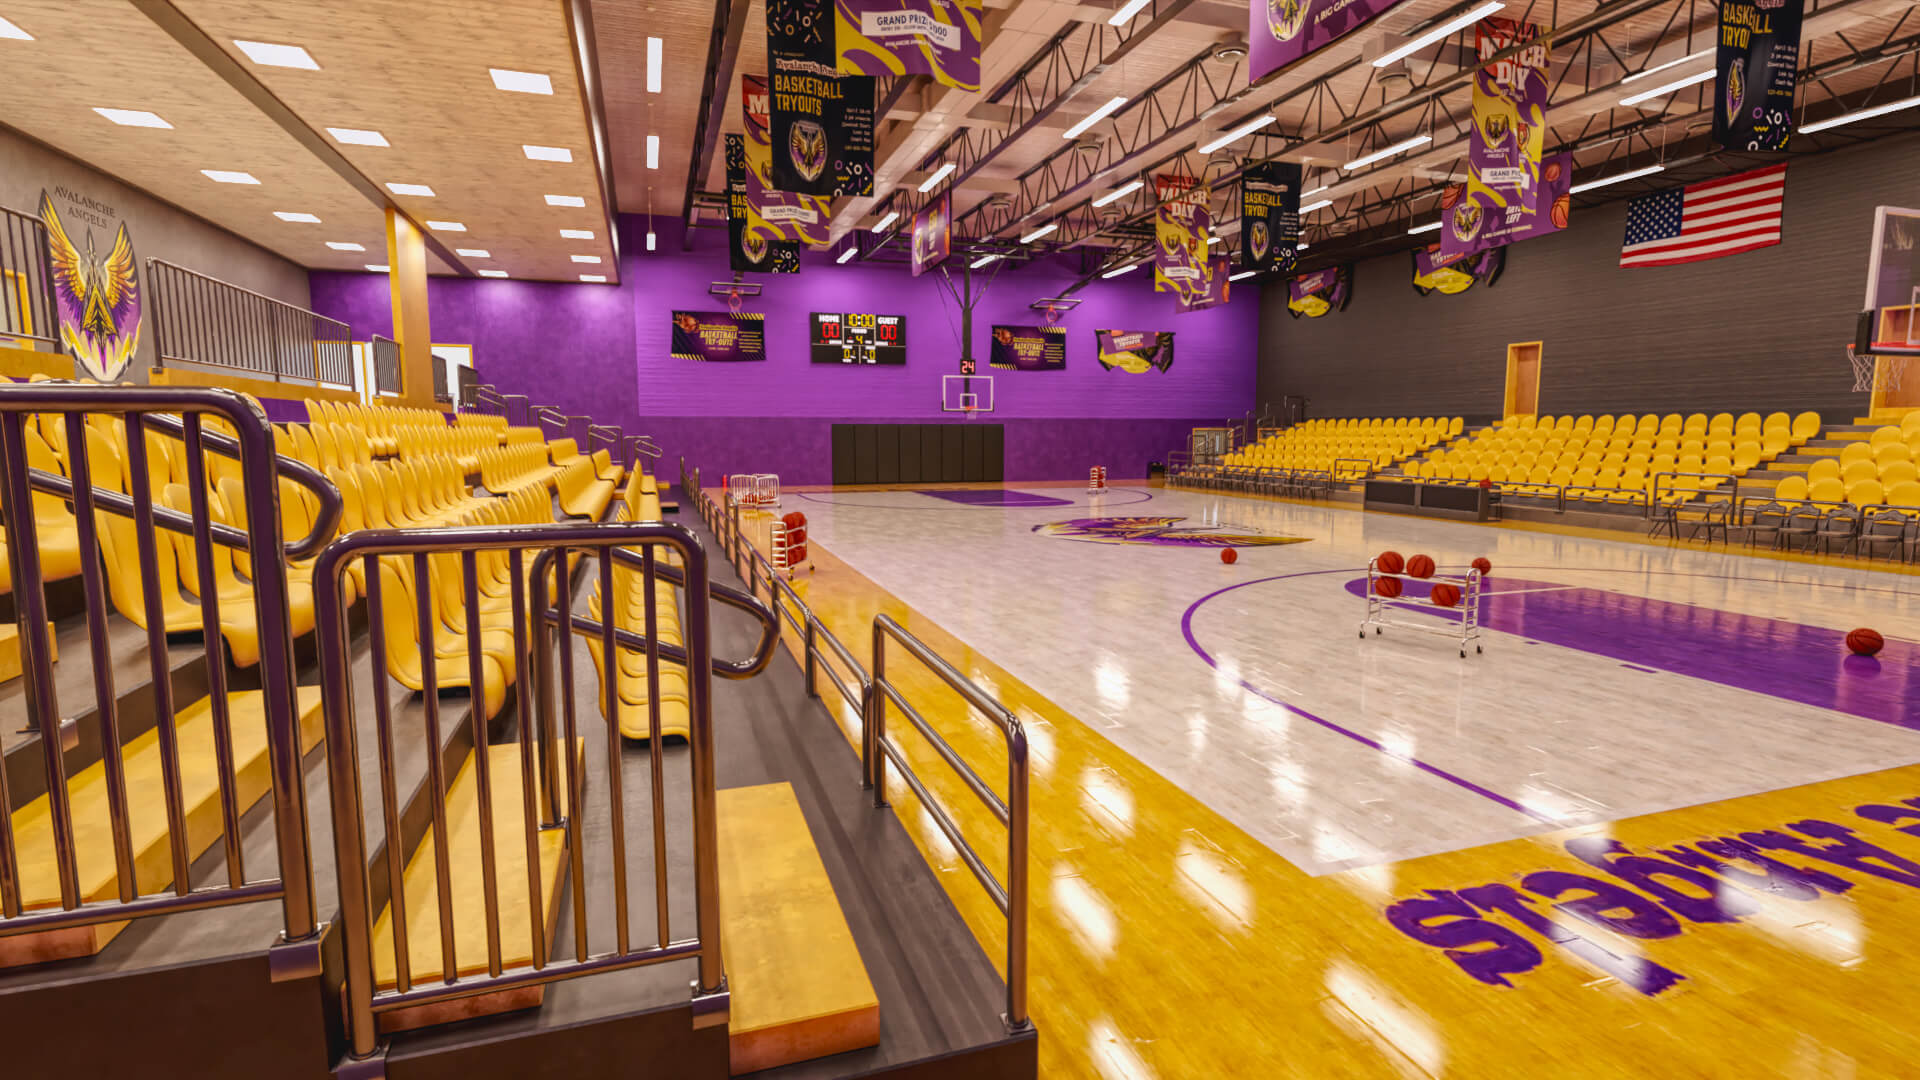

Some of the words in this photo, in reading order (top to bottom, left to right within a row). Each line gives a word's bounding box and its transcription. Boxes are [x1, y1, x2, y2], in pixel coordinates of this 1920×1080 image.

[876, 15, 907, 26] GRAND
[909, 14, 929, 25] PRIZ
[775, 74, 844, 99] BASKETBALL
[775, 94, 822, 116] TRYOUTS
[54, 185, 116, 219] AVALANCHE
[68, 206, 107, 229] ANGELS
[818, 314, 840, 323] HOME
[848, 313, 875, 328] 10:00
[878, 316, 899, 325] GUEST
[822, 322, 840, 338] 00
[880, 324, 897, 340] 00
[961, 360, 975, 374] 24
[1384, 818, 1920, 998] Angels
